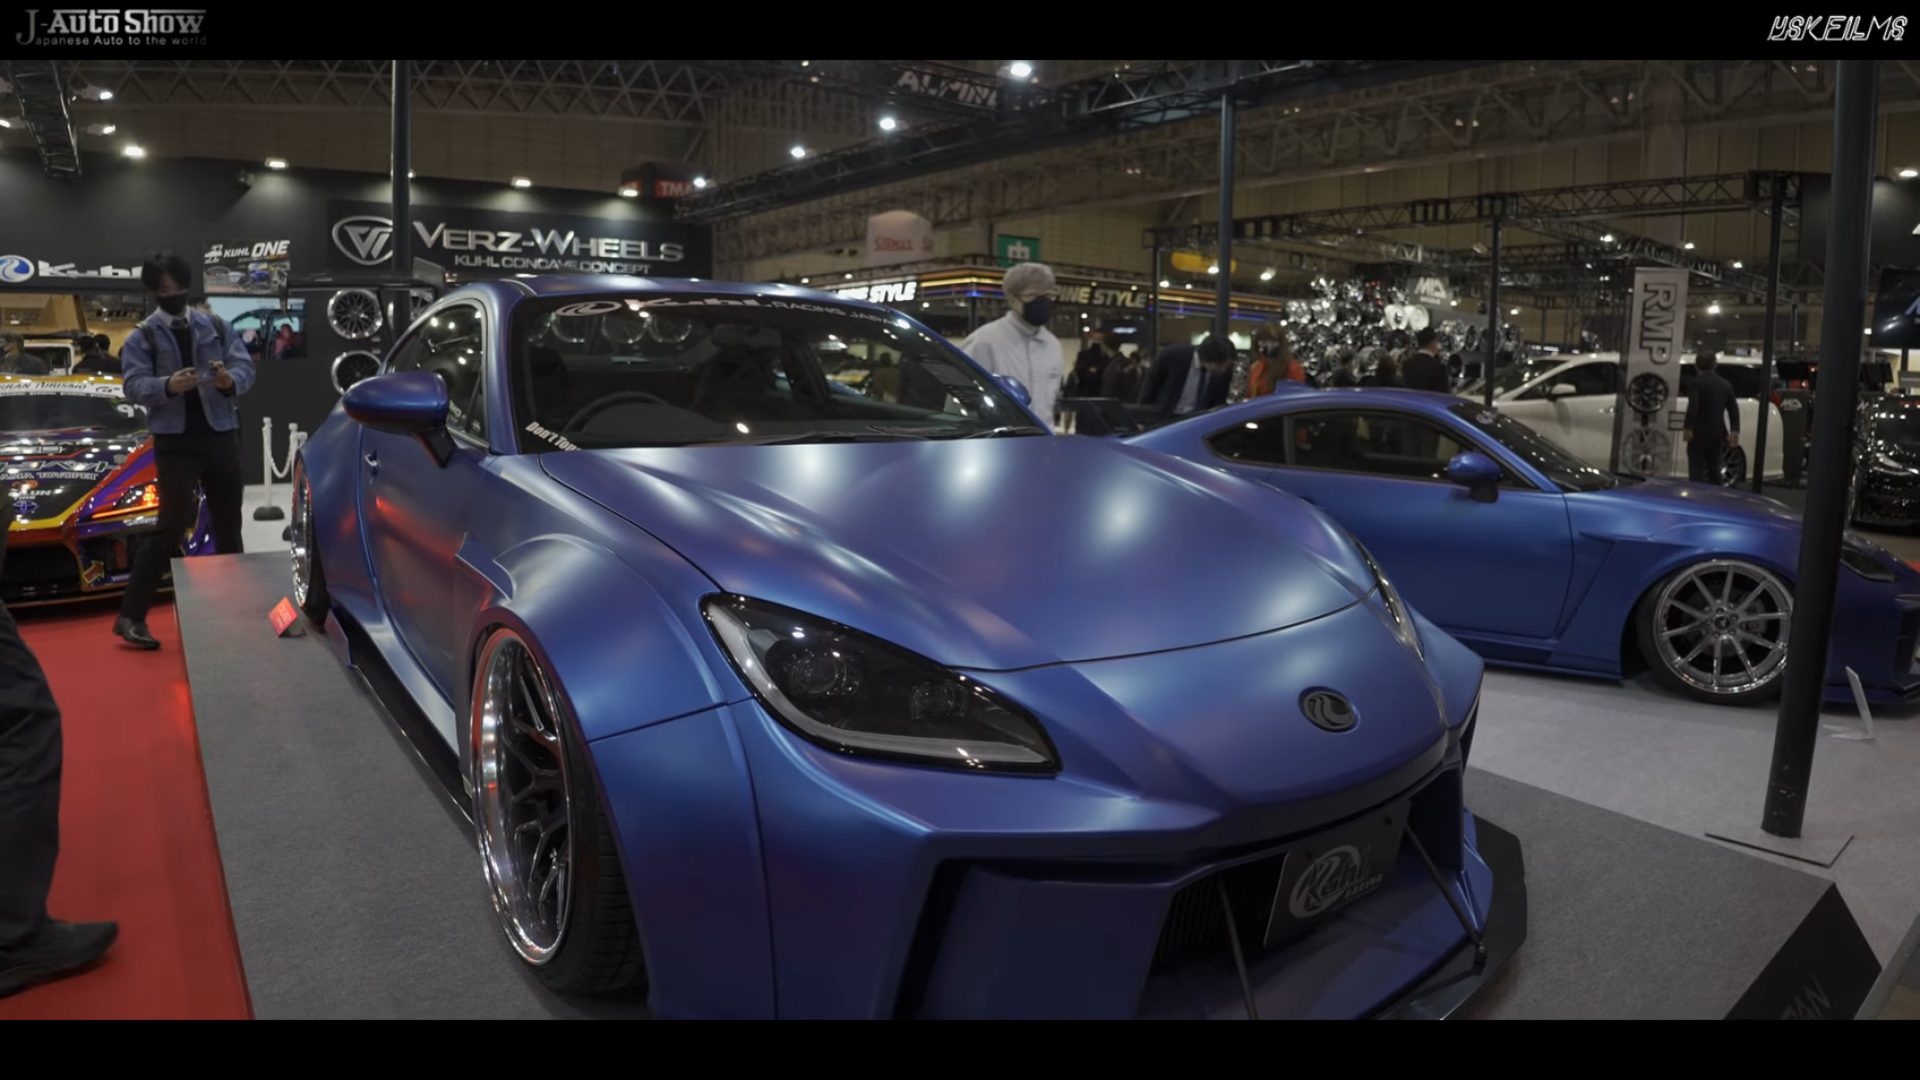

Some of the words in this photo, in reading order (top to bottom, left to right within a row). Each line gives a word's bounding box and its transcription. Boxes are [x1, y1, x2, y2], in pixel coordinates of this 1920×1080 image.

[251, 240, 290, 258] ONE
[454, 254, 500, 268] KUHL
[579, 260, 651, 275] CONCEPT
[869, 281, 917, 303] STYLE
[1091, 288, 1148, 309] STYLE
[1639, 282, 1678, 366] RMP
[525, 421, 558, 443] Don't
